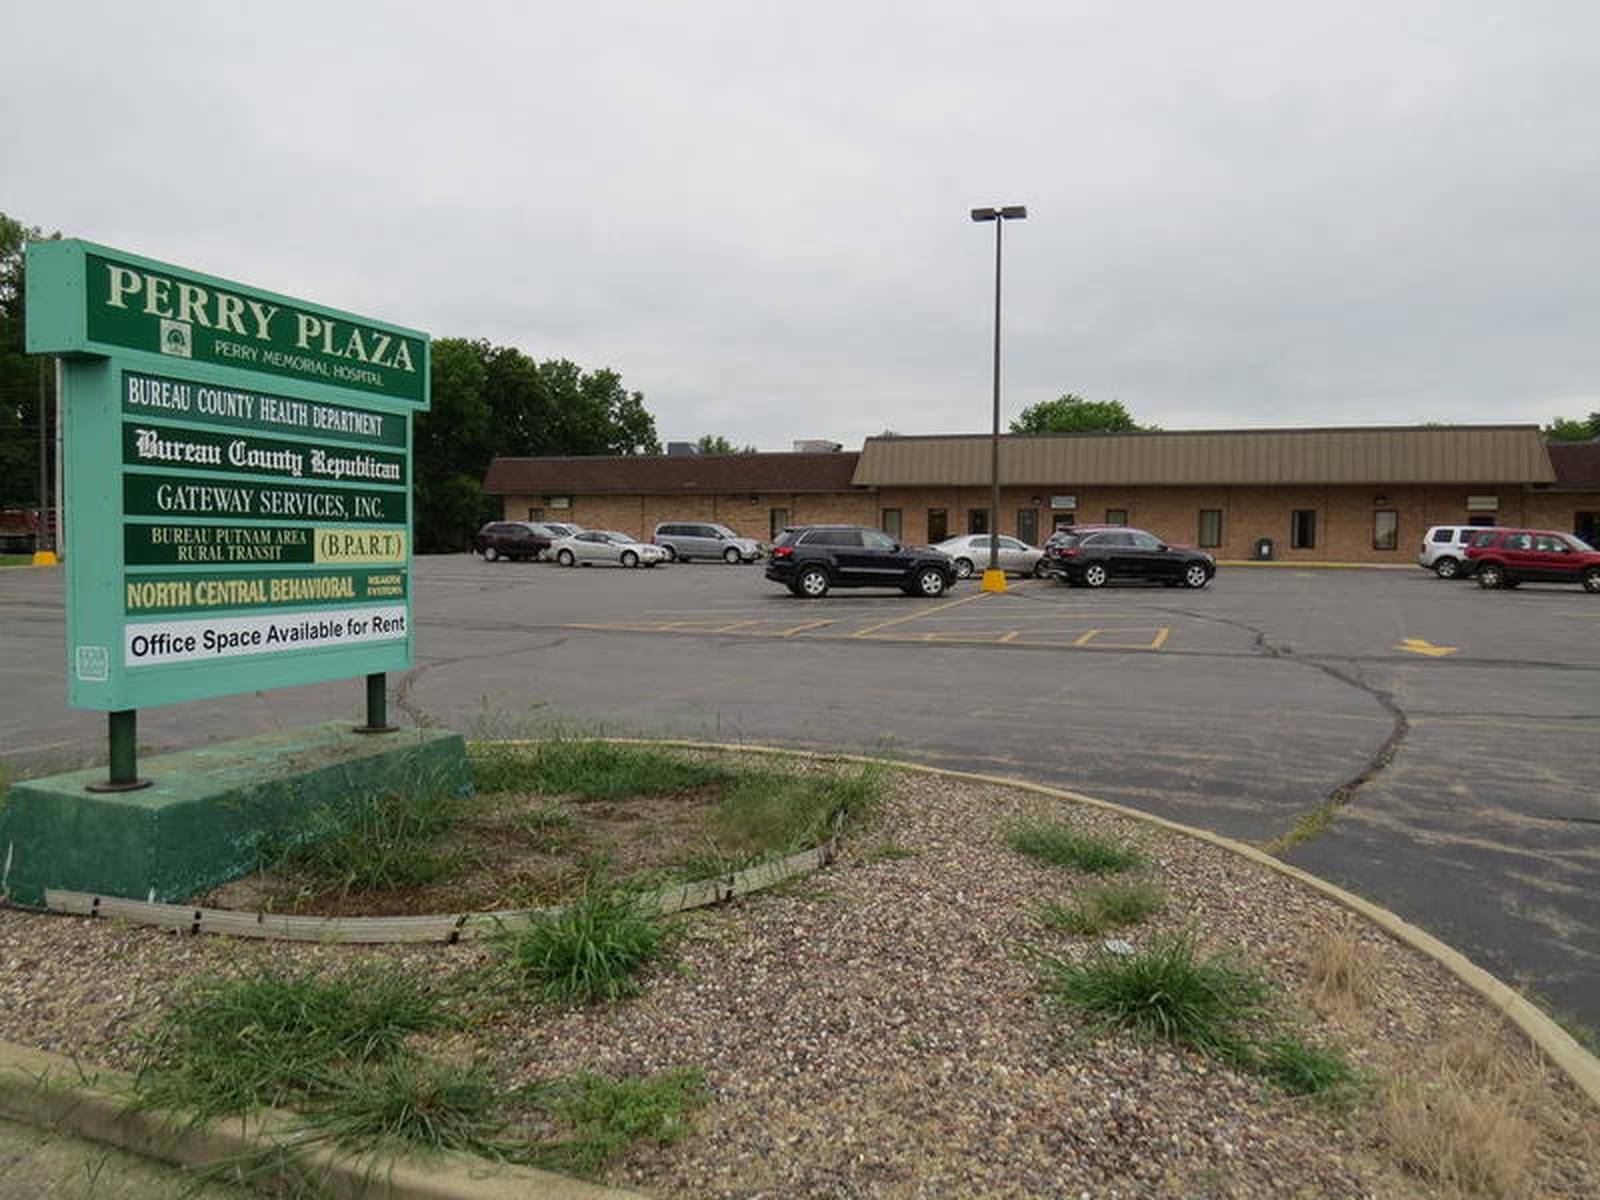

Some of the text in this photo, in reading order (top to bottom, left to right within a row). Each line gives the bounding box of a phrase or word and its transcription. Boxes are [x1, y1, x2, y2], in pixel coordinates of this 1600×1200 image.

[105, 265, 416, 373] PERRY PLAZA
[214, 339, 385, 387] PERRY MEMORIAL HOSPITAL
[128, 377, 384, 437] BUREAU COUNTY HEALTH DEPARTMENT
[134, 429, 400, 481] Bureau County Republican
[157, 484, 385, 519] GATEWAY SERVICES, INC.
[151, 527, 307, 544] BUREAU PUTNAM AREA
[178, 545, 283, 561] RURAL TRANSIT
[127, 582, 191, 608] NORTH
[195, 579, 268, 605] CENTRAL
[270, 576, 356, 602] BEHAVIORAL
[131, 616, 405, 657] Office Space Available for Rent
